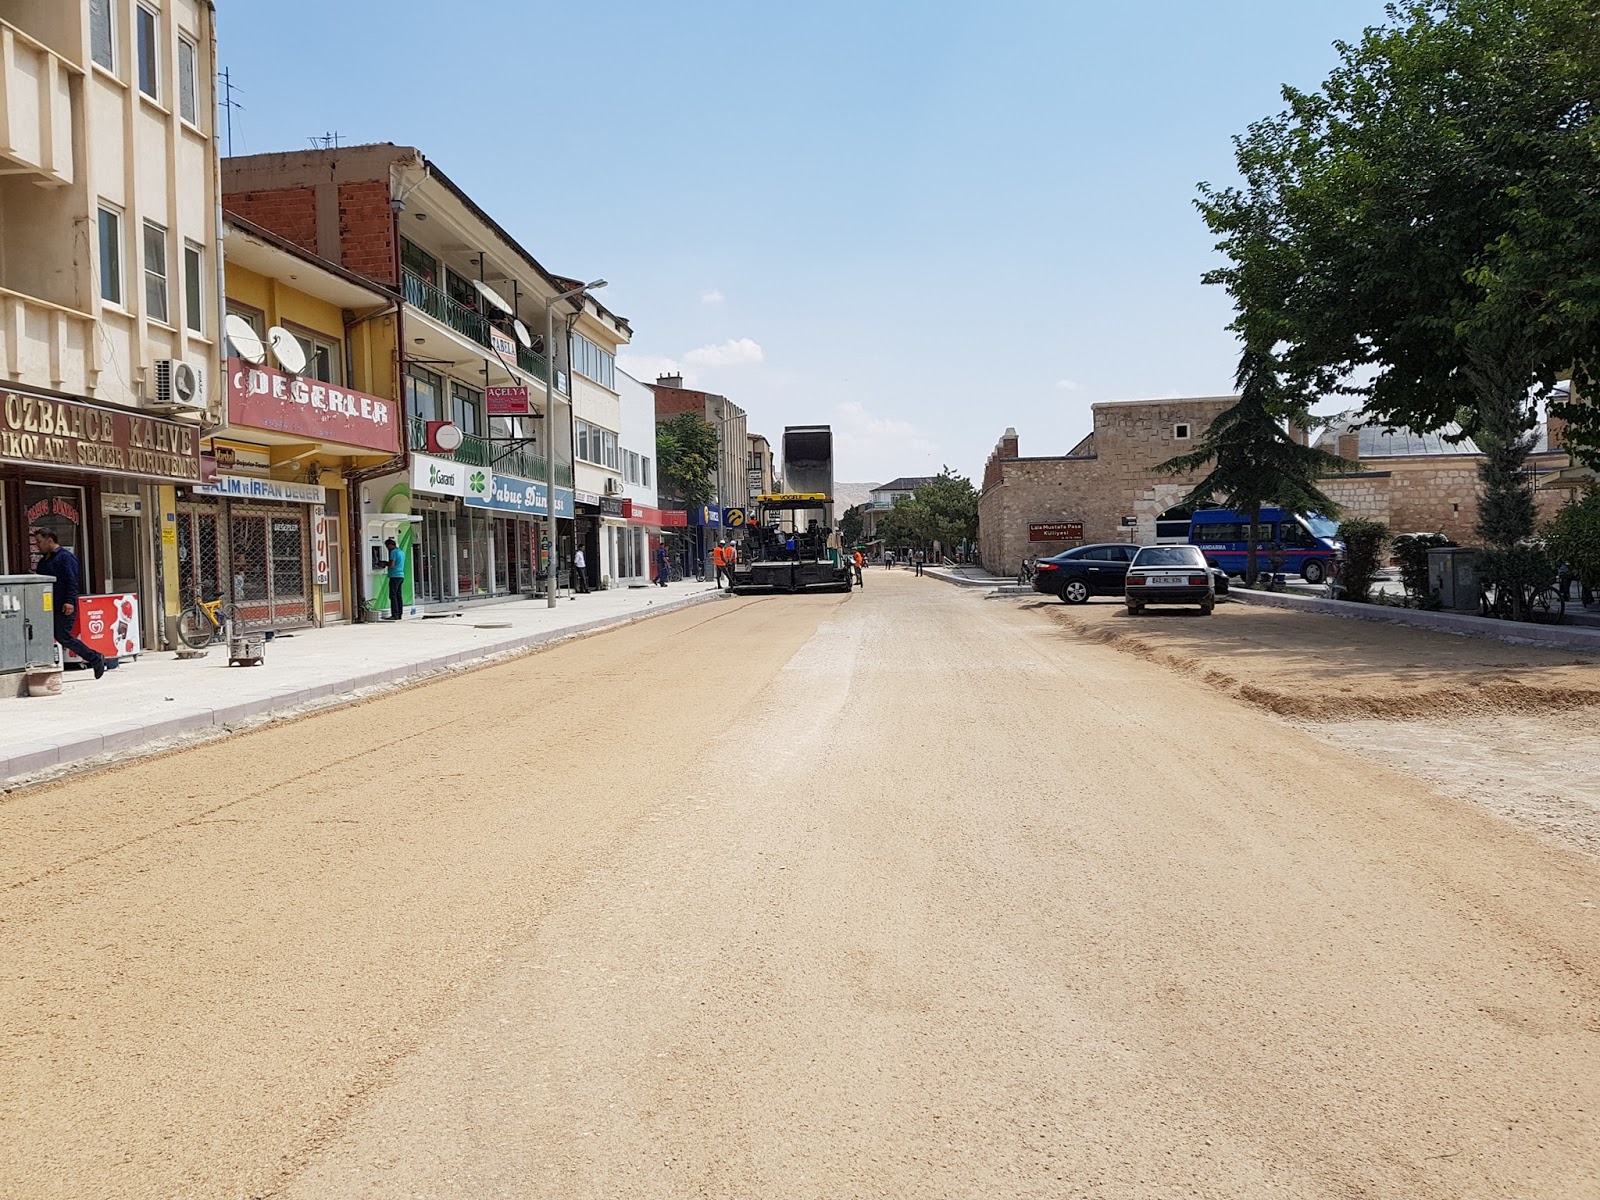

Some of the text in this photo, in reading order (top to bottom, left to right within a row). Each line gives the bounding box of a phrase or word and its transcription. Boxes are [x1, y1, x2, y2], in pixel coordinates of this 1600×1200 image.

[492, 336, 516, 357] TABELA
[488, 388, 526, 398] AÇELYA
[0, 428, 73, 464] İKOLATA
[128, 416, 192, 456] KAHVE
[250, 478, 281, 497] İRFAN
[436, 469, 455, 486] Garanti
